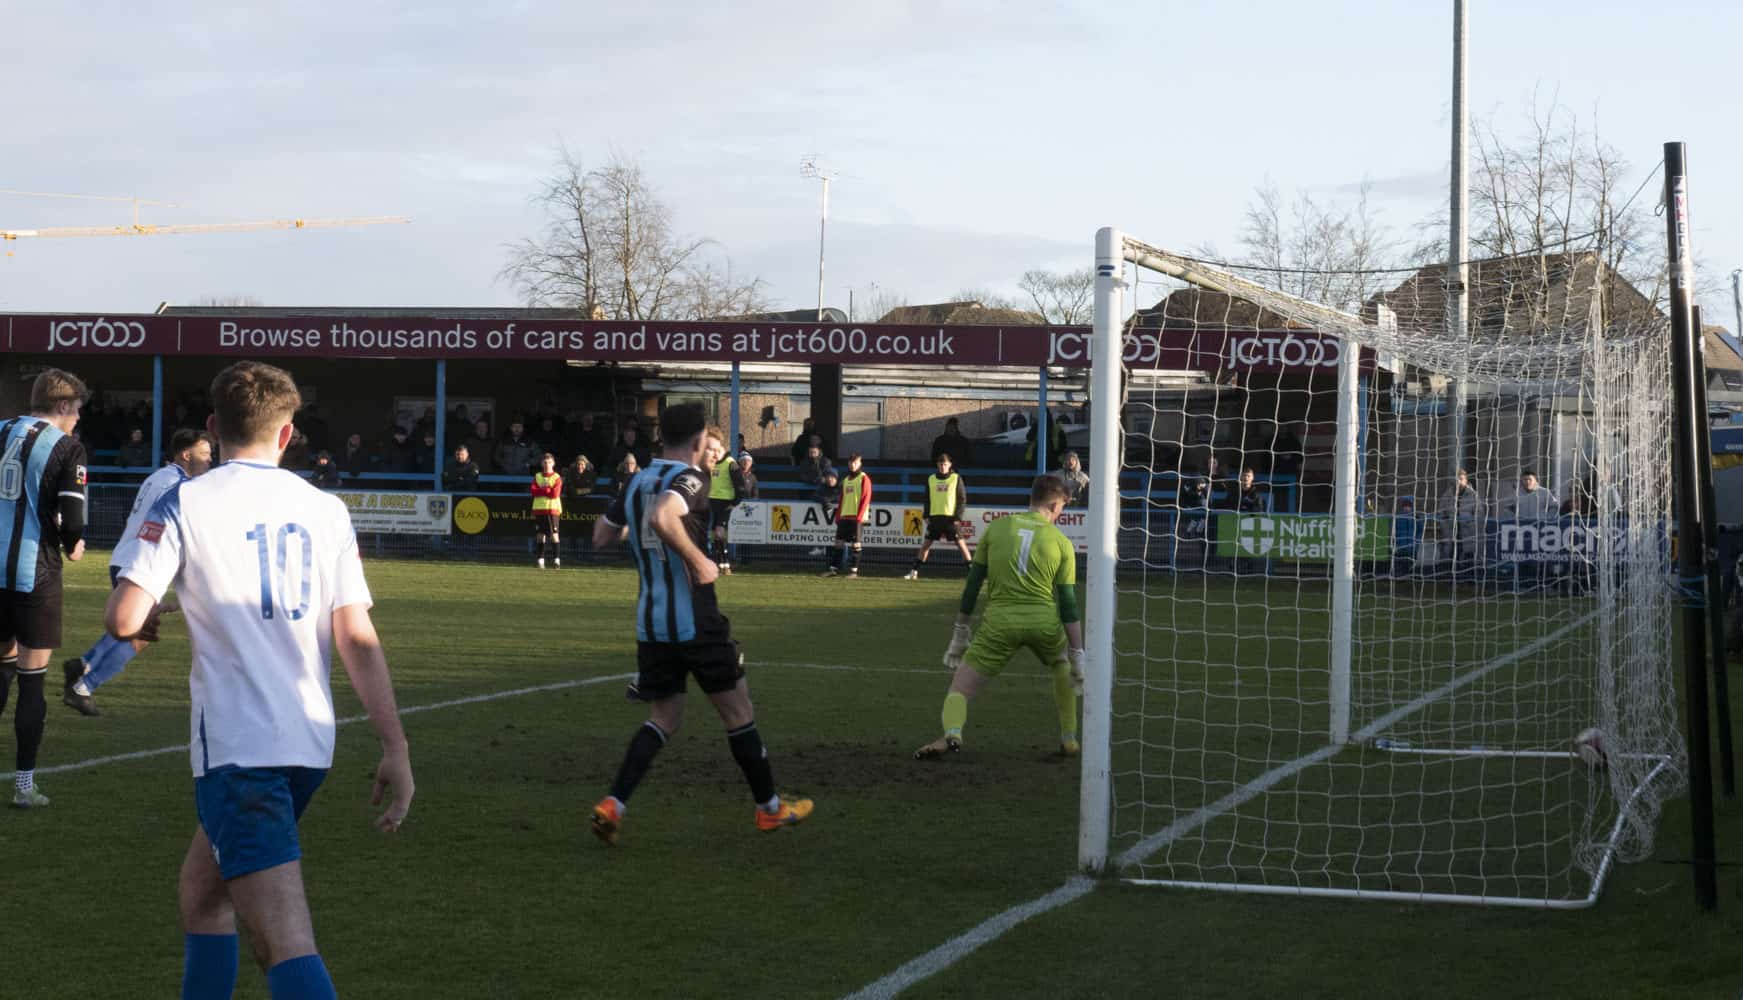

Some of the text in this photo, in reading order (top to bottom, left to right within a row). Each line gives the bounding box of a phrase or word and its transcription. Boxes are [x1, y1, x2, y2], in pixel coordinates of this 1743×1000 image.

[47, 318, 146, 351] JCT600
[220, 322, 954, 358] Browse thousands of cars and vans at jct600.co.uk
[1047, 333, 1159, 364] JCT00
[1228, 334, 1341, 368] JCT600
[771, 534, 814, 542] HELPING
[863, 536, 883, 544] DER
[886, 537, 922, 545] PEOPLE
[1017, 528, 1035, 576] 1
[1280, 540, 1335, 558] Healt
[247, 523, 312, 620] 10
